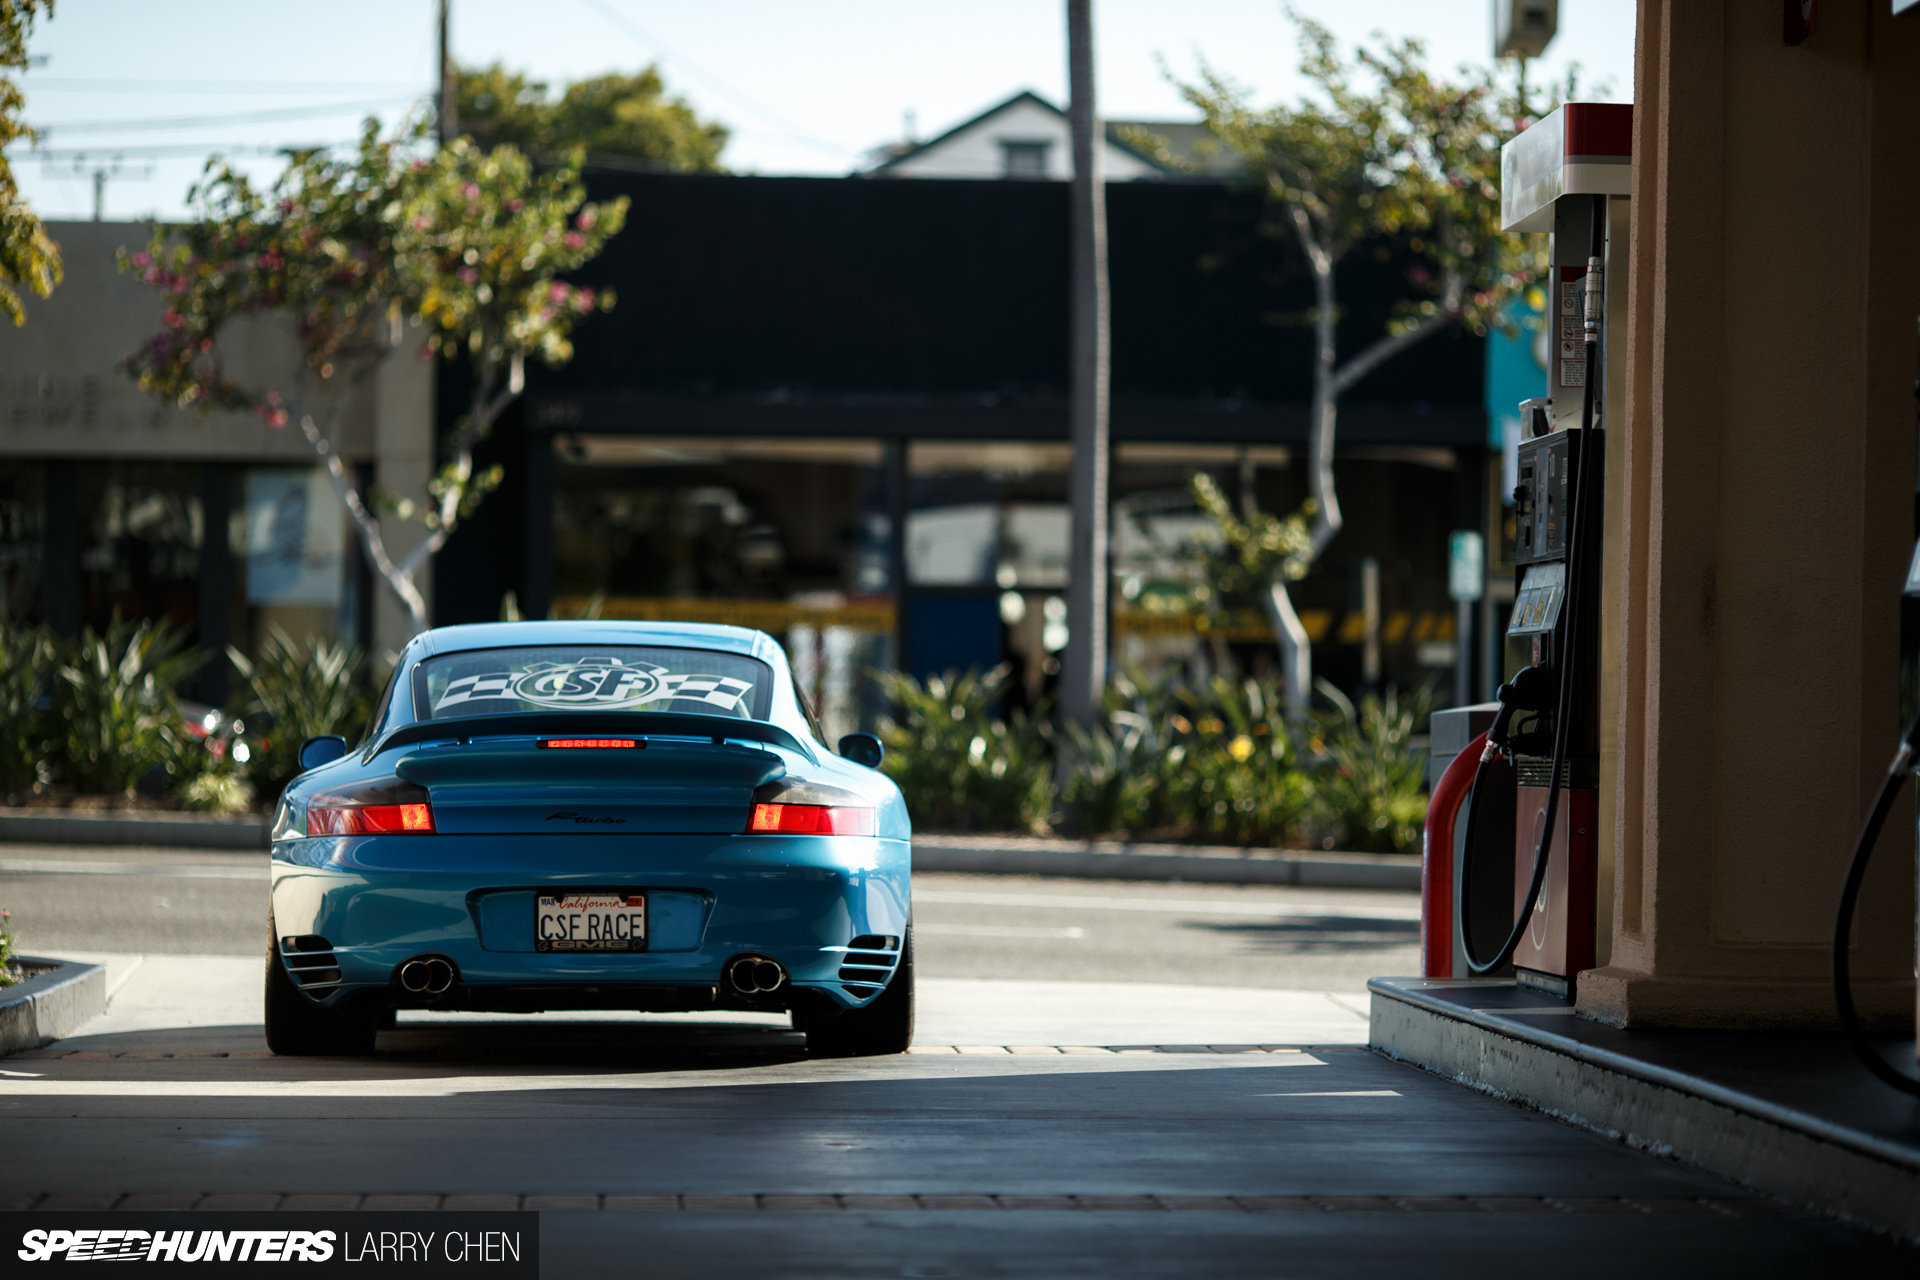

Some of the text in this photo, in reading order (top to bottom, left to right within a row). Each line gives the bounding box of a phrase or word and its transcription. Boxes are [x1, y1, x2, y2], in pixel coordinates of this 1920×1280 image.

[536, 669, 646, 700] CSF
[541, 897, 556, 905] MAR
[559, 896, 627, 912] California
[541, 914, 642, 940] CSF RACE
[552, 940, 629, 948] GMG
